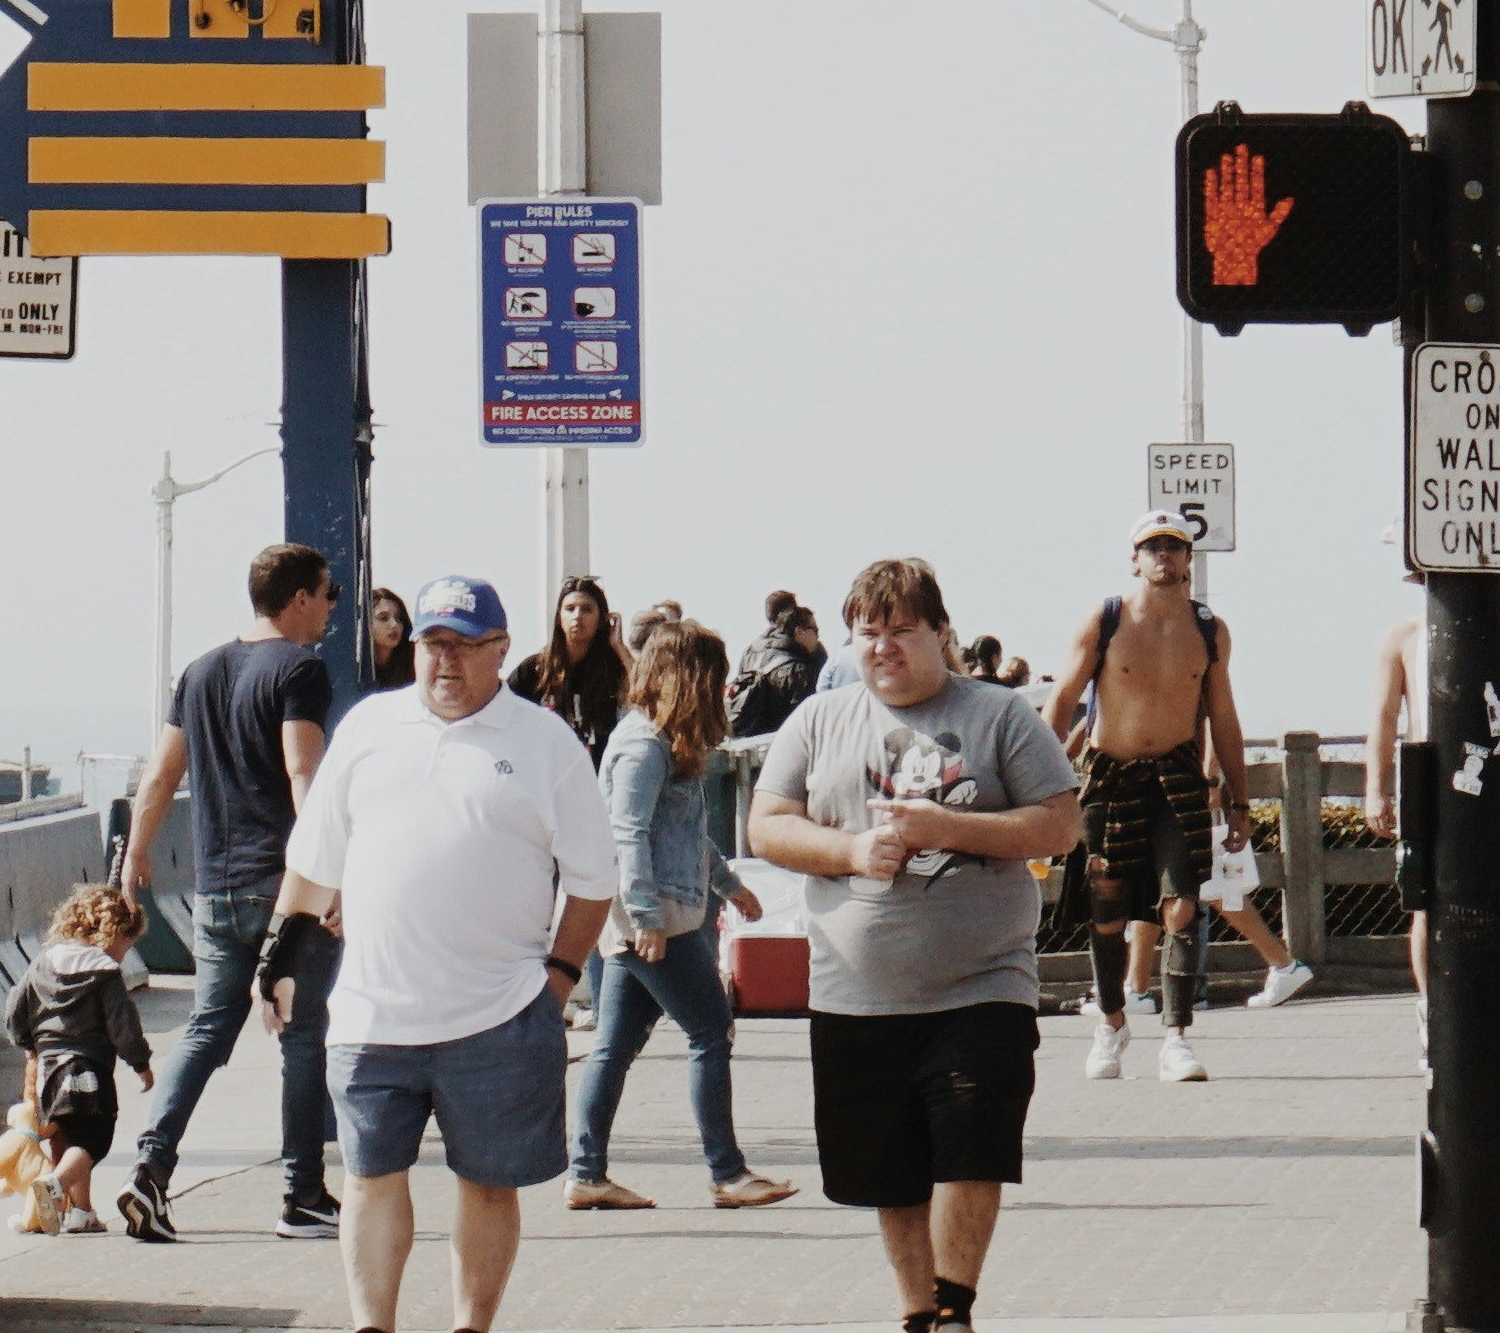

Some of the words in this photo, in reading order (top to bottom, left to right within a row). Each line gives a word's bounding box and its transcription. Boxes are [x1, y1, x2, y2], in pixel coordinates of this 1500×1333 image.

[526, 206, 553, 218] PIER
[7, 271, 62, 286] EXEMPT
[18, 301, 60, 321] ONLY
[19, 323, 64, 335] MON-FRI
[1430, 359, 1500, 394] CRO
[491, 406, 523, 420] FIRE
[526, 406, 589, 420] ACCESS
[591, 405, 634, 420] ZONE
[1466, 403, 1500, 430] ON
[1154, 453, 1229, 470] SPEED
[1436, 437, 1500, 471] WAL
[1161, 478, 1222, 494] LIMIT
[1422, 478, 1499, 513] SIGN
[1180, 502, 1208, 542] 5
